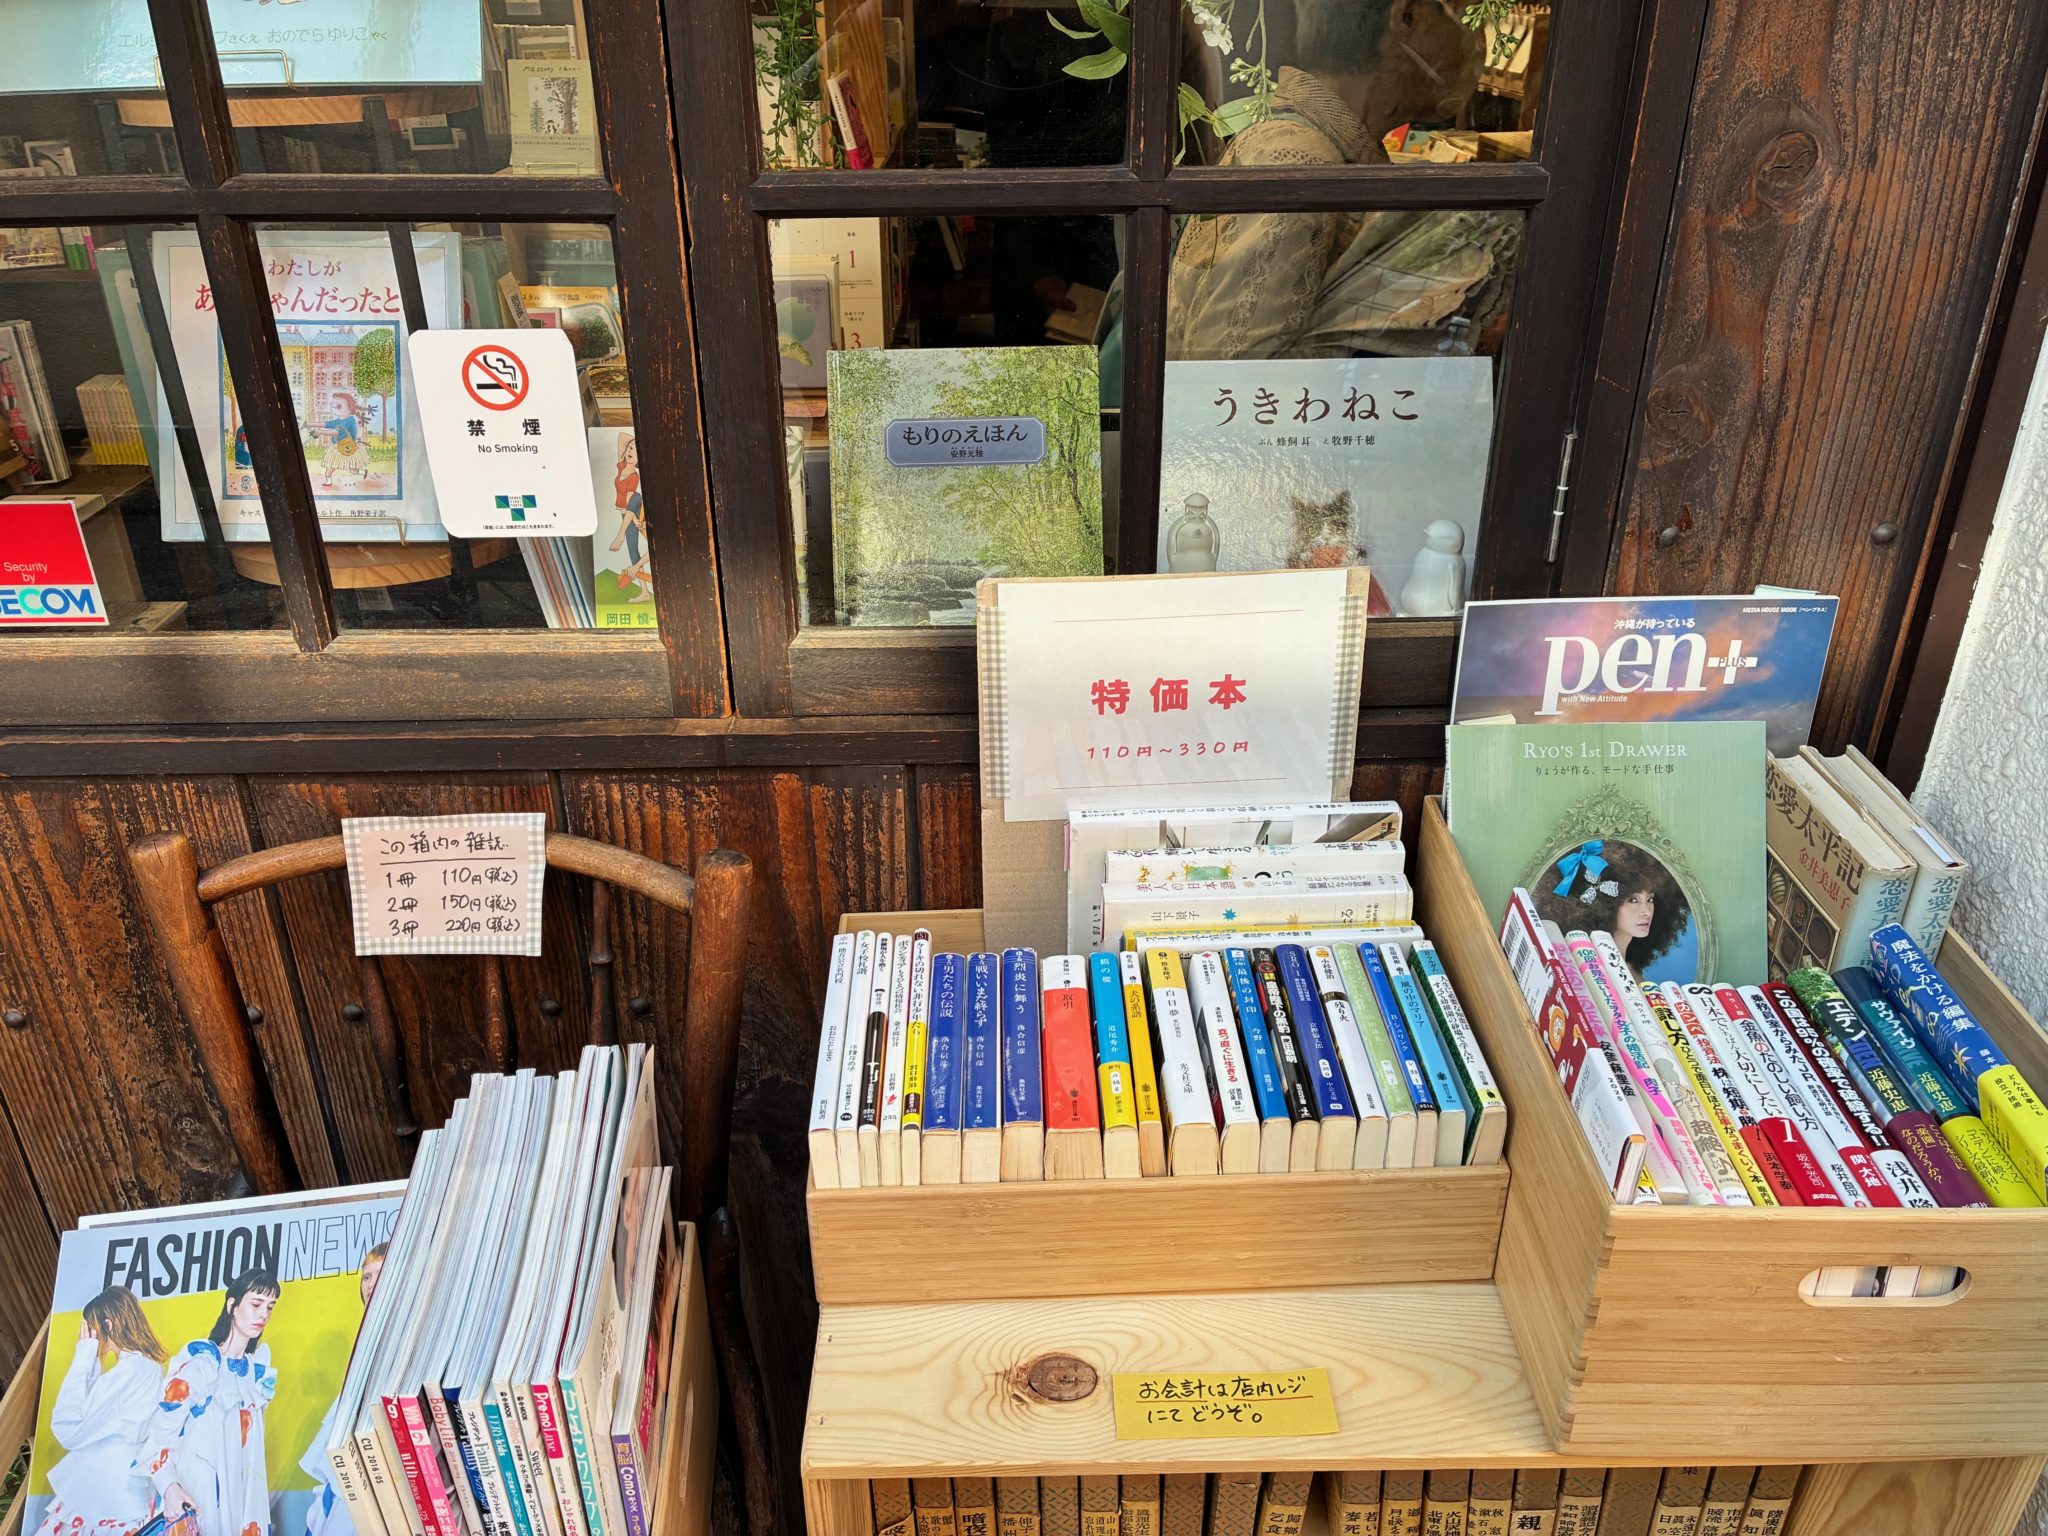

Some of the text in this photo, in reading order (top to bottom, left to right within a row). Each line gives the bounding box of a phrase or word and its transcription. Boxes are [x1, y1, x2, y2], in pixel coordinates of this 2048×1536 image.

[268, 259, 342, 277] わたしが
[1213, 387, 1419, 426] うきわねこ
[467, 418, 541, 437] 禁煙
[903, 425, 1027, 447] もりのえほん
[1331, 434, 1375, 447] 牧野千穂
[478, 443, 538, 455] No Smoking
[3, 562, 48, 573] Security
[22, 573, 36, 584] by
[0, 588, 97, 615] ECOM
[606, 613, 631, 626] 岡田
[1613, 617, 1696, 630] 沖縄が待っている
[1533, 632, 1747, 716] pen PLUS
[1090, 673, 1248, 716] 特価本
[1560, 694, 1628, 704] with New Attitude
[1523, 741, 1687, 759] RYO'S 1st DRAWER
[1136, 881, 1236, 892] 美人の日本語
[387, 897, 419, 913] 2冊
[1151, 910, 1200, 921] 山下景子
[389, 919, 419, 938] 3冊
[939, 965, 955, 1018] 男たちの伝説
[1237, 968, 1257, 1014] 最後の封印
[1890, 937, 1976, 1034] 魔法をかける編集
[1062, 994, 1074, 1010] 取引
[1165, 989, 1180, 1017] 白日夢
[1400, 981, 1425, 1029] 風の中のマリア
[1751, 993, 1817, 1082] 乗務員室からみたJR
[1217, 1028, 1238, 1083] 真っ直ぐに生きる
[1700, 996, 1783, 1117] 日本でいちばん大切にしたい
[1779, 1119, 1798, 1143] 1
[1826, 999, 1867, 1043] エデン
[1868, 1066, 1912, 1115] 近藤史恵
[1739, 1019, 1819, 1132] 金魚のたのしい飼い方
[1917, 1072, 1957, 1112] 近藤史恵
[1994, 1077, 2023, 1110] 役立つ技術
[2008, 1074, 2044, 1117] どんな仕事にも
[102, 1222, 283, 1298] FASHION
[1138, 1375, 1306, 1399] お会計は店内レジ
[430, 1397, 446, 1425] Baby
[474, 1442, 496, 1478] Family
[620, 1466, 636, 1497] Como
[1516, 1515, 1542, 1531] 親
